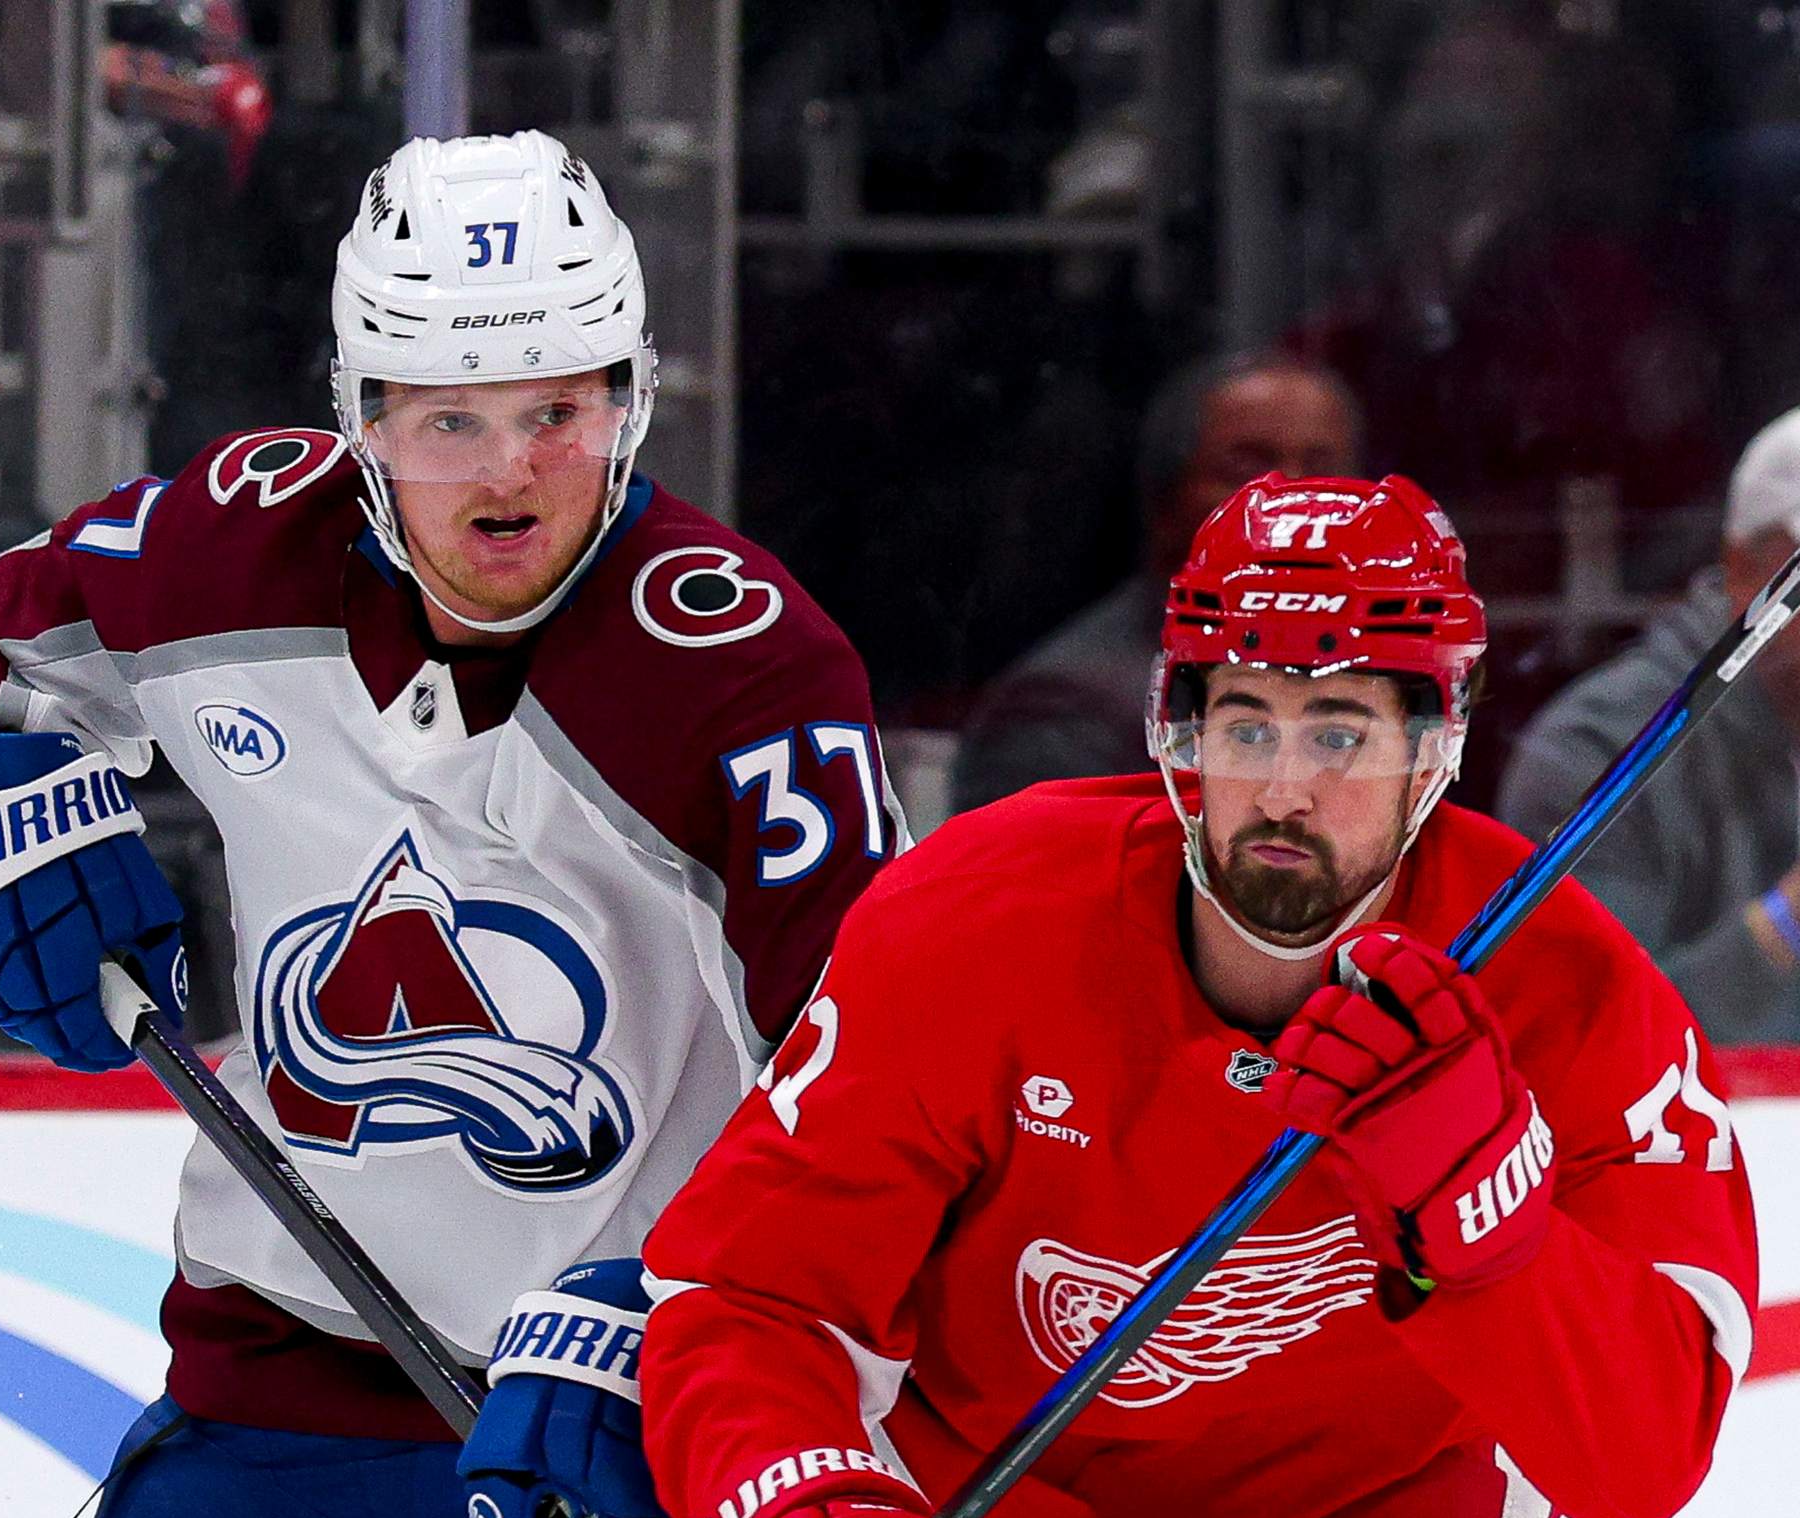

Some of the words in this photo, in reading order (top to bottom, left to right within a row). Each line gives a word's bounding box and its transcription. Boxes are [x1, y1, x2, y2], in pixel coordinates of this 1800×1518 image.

[464, 222, 519, 268] 37
[450, 310, 546, 329] BAUER
[66, 474, 174, 559] 7
[1262, 513, 1329, 549] 71
[1240, 591, 1347, 613] CCM
[204, 717, 265, 761] IMA
[718, 721, 885, 888] 37
[1236, 1065, 1267, 1081] NHL
[1455, 1090, 1553, 1243] RIOR
